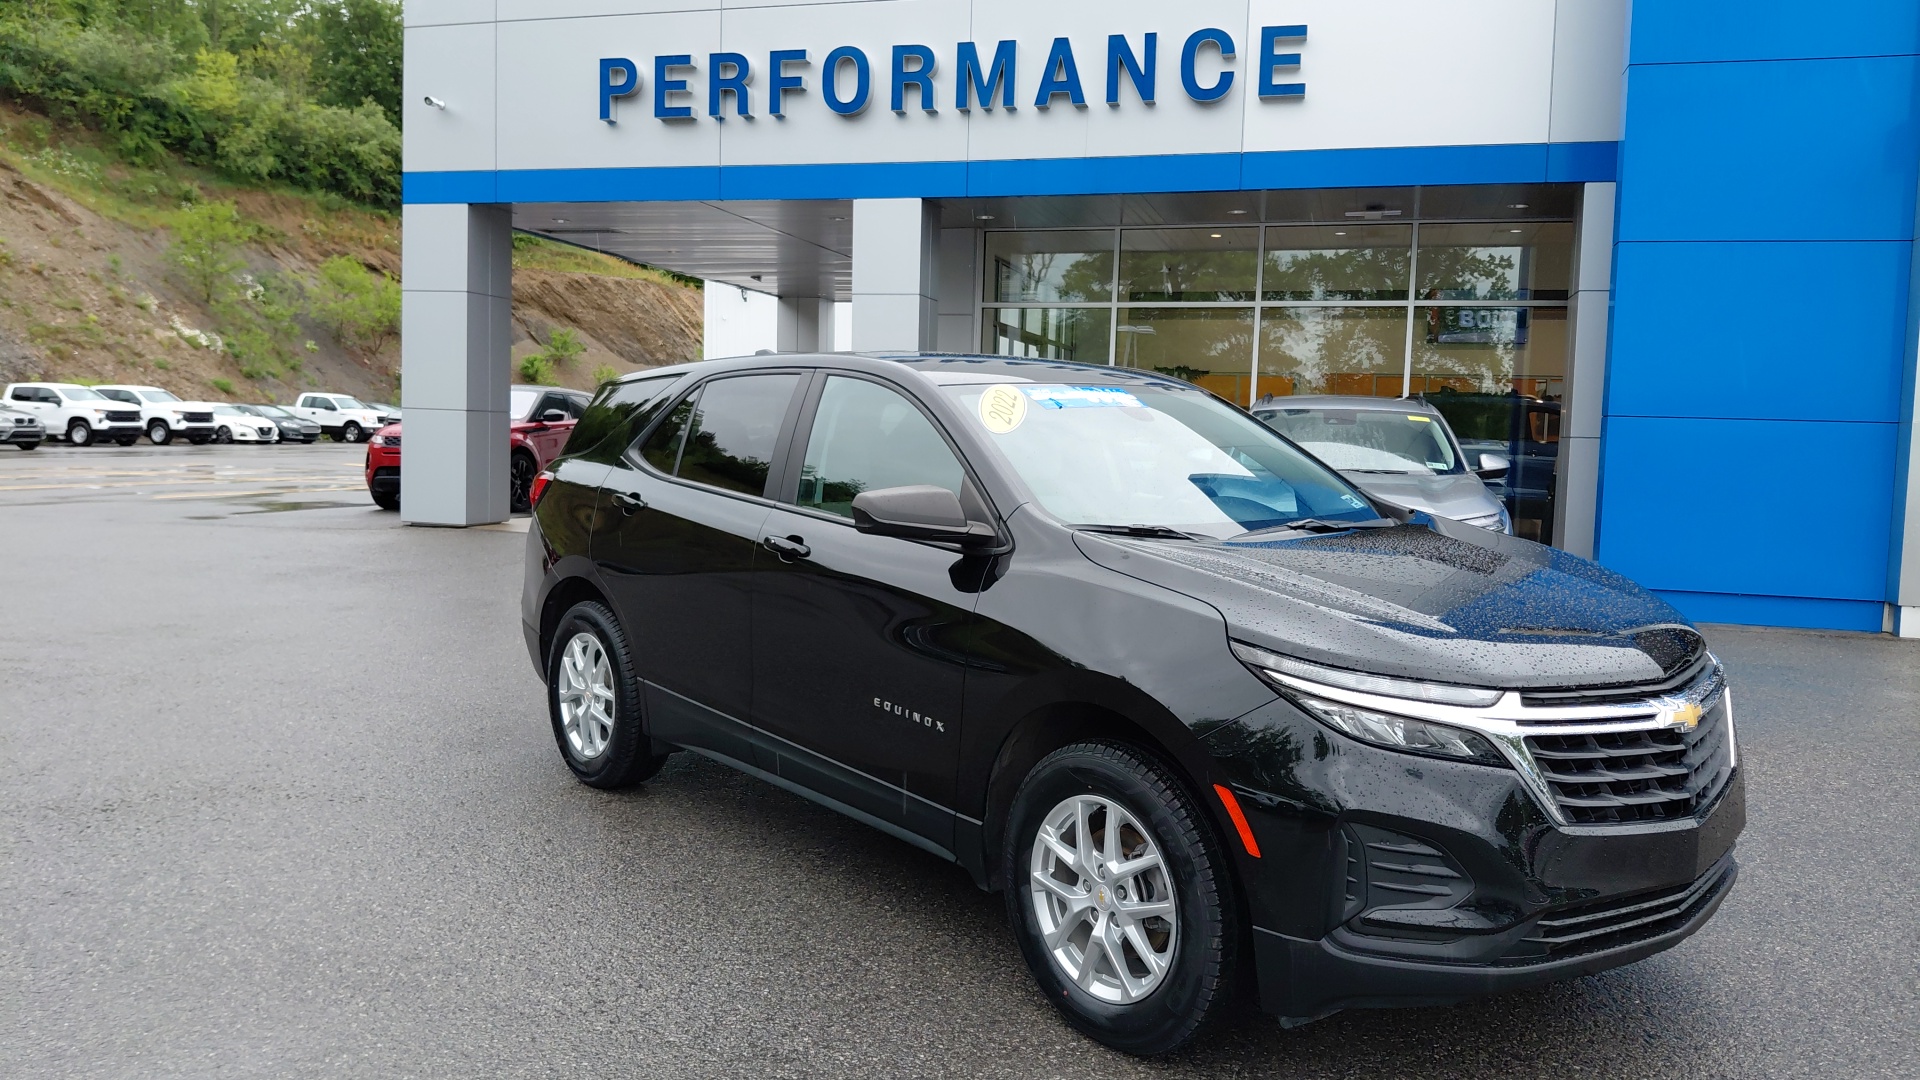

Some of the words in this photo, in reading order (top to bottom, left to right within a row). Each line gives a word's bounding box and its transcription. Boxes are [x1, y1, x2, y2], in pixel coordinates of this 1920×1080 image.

[599, 24, 1308, 122] PERFORMANCE
[988, 389, 1018, 426] 2022
[873, 697, 945, 733] EQUINOX
